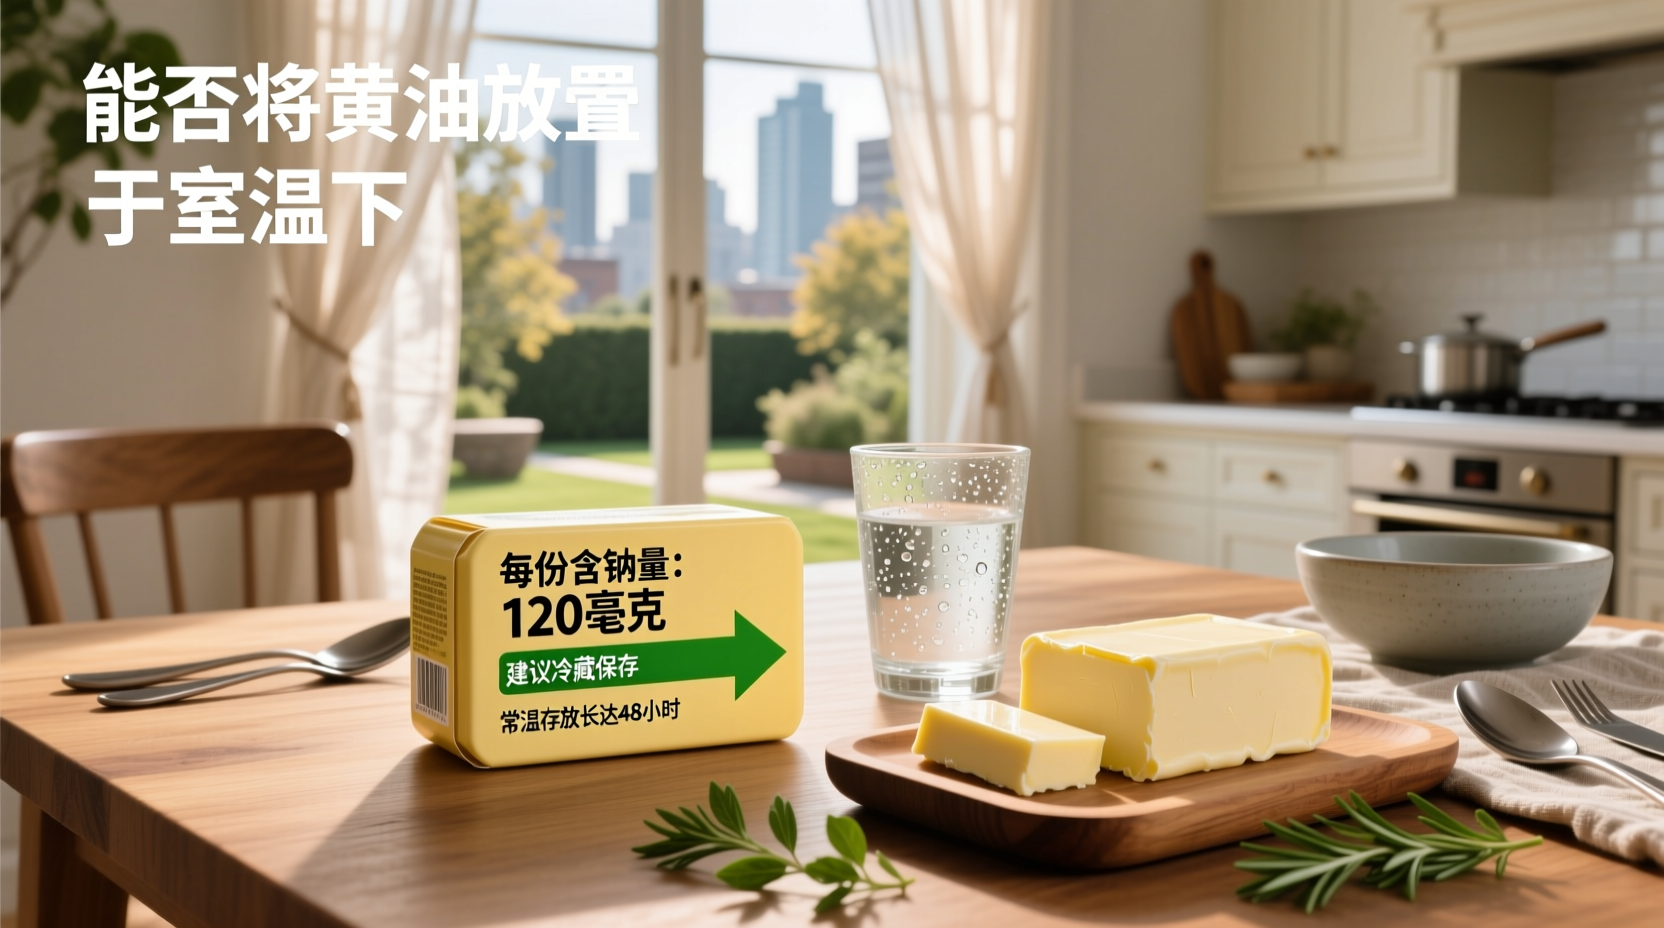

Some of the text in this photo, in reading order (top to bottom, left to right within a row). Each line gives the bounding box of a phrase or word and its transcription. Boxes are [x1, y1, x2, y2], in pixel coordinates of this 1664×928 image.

[500, 547, 682, 589] 每份含钠量：
[503, 587, 666, 639] 120毫克
[505, 653, 639, 688] 建议冷藏保存
[500, 697, 681, 735] 常温存放长达48小时
